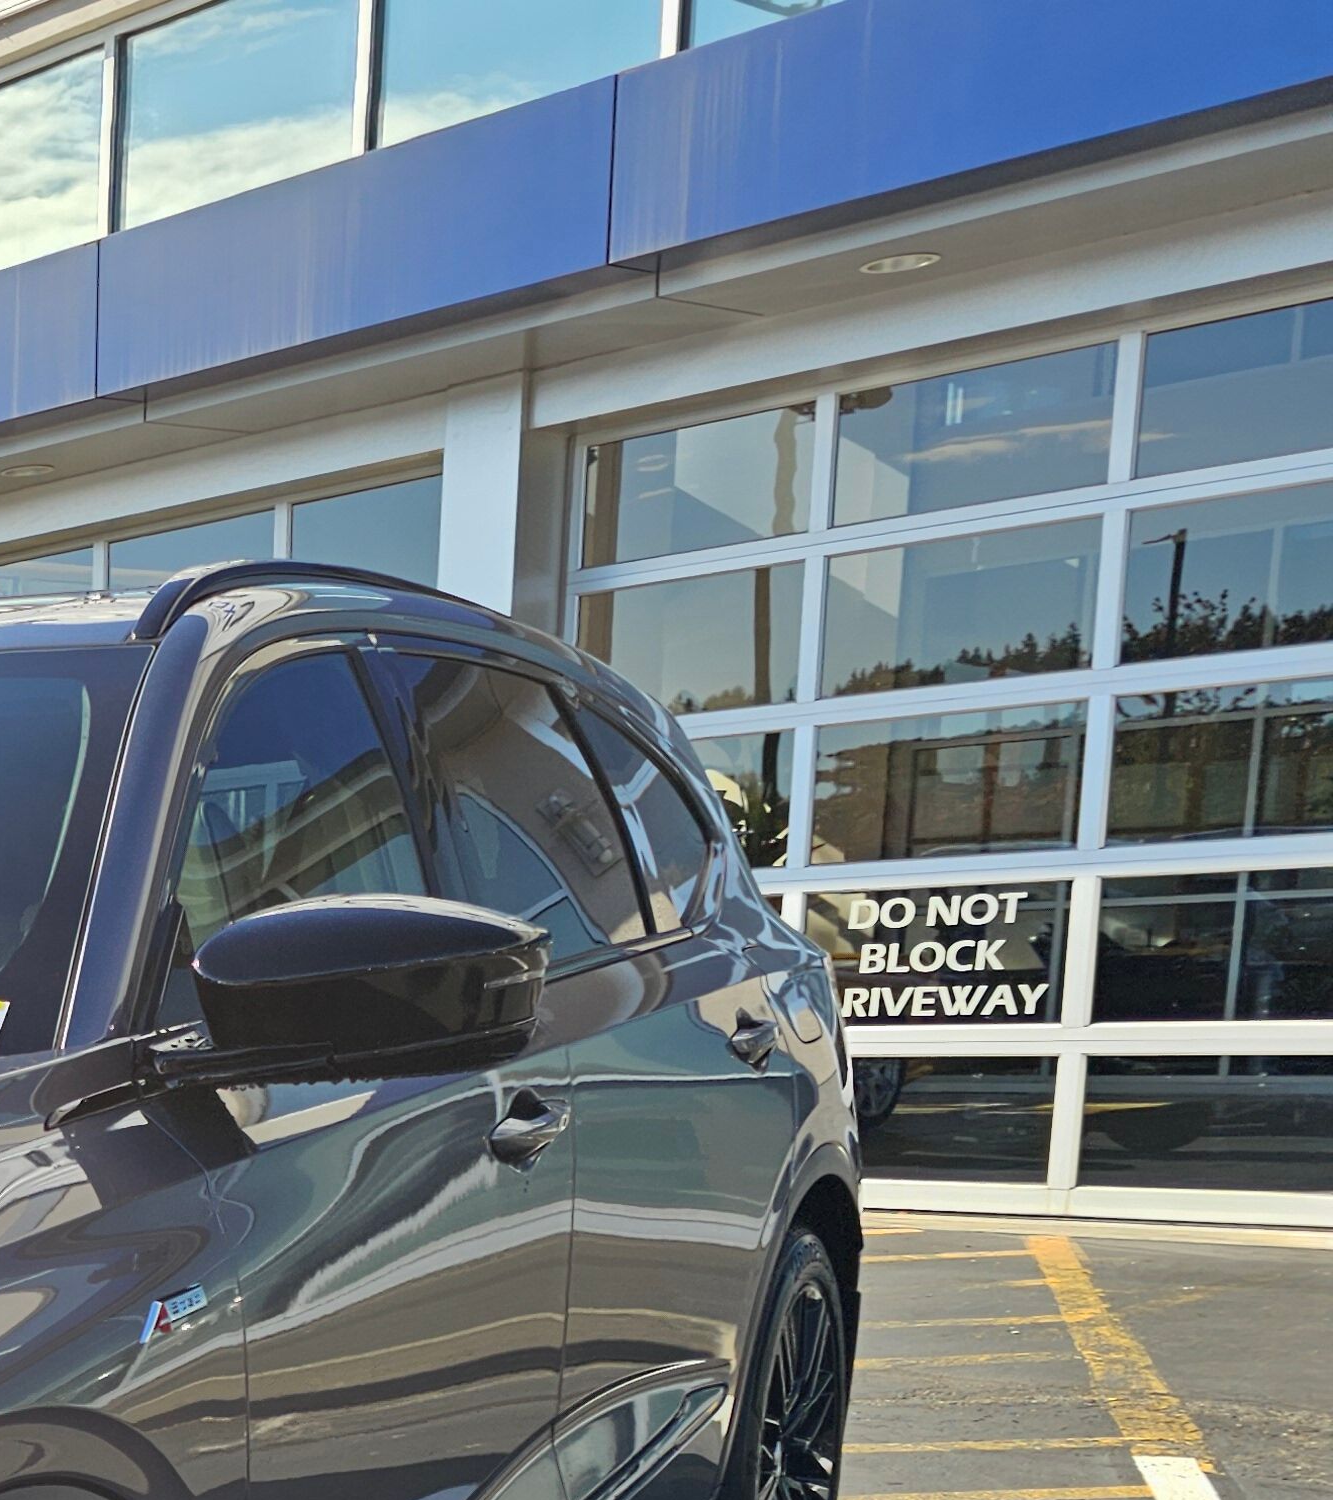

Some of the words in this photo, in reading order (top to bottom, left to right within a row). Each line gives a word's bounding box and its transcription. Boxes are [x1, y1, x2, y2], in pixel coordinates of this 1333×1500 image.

[847, 897, 917, 930] DO
[925, 891, 1029, 927] NOT
[858, 939, 1007, 974] BLOCK
[841, 983, 1050, 1018] RIVEWAY
